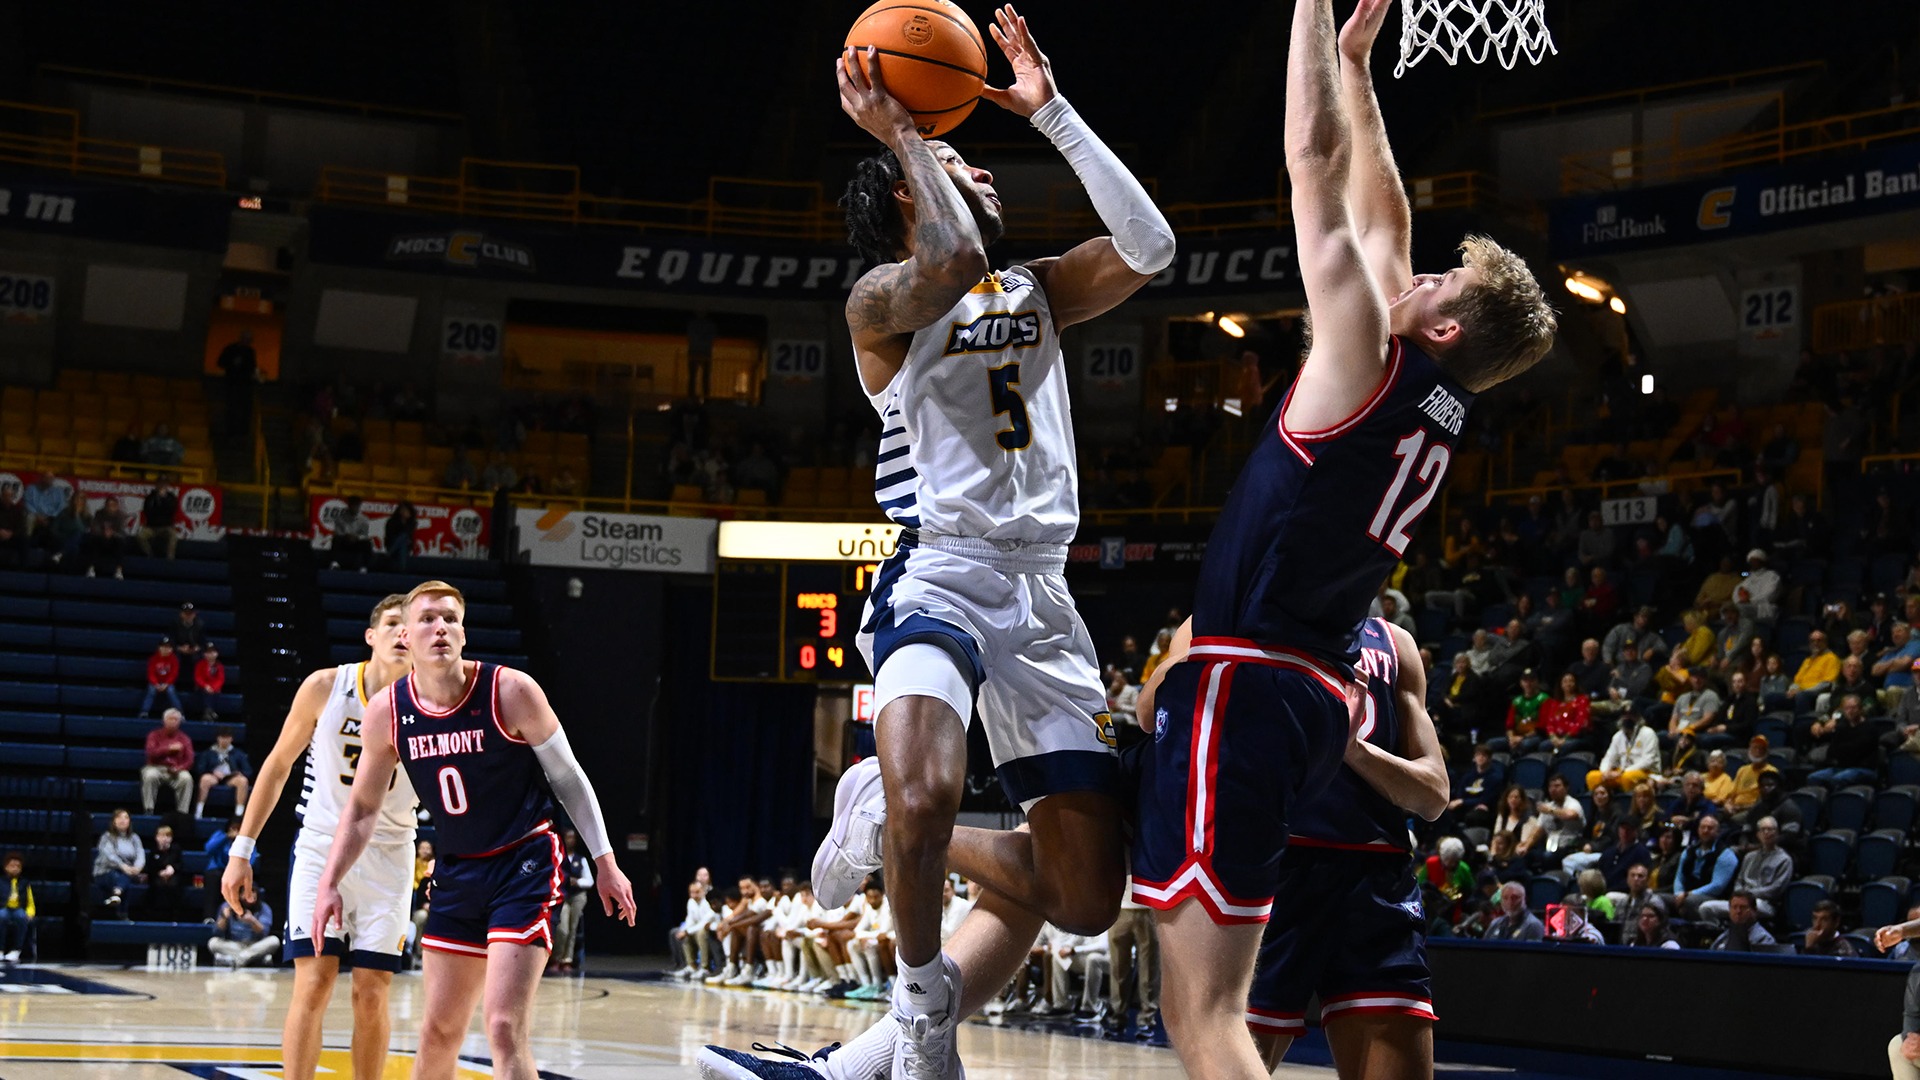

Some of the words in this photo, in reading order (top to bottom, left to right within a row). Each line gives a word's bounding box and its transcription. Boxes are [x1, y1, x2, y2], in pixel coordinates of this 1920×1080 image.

[1759, 174, 1856, 216] Official
[1864, 162, 1920, 199] Ban
[1582, 214, 1666, 244] FirstBank
[394, 237, 445, 255] MOCS
[482, 242, 530, 267] CLUB
[0, 277, 49, 309] 208
[1746, 290, 1793, 326] 212
[447, 322, 497, 352] 209
[776, 343, 821, 371] 210
[1090, 347, 1133, 376] 210
[988, 362, 1033, 451] 5
[1417, 384, 1466, 436] FRIBERG
[1366, 426, 1451, 559] 12
[1612, 500, 1646, 521] 113
[582, 517, 663, 541] Steam
[581, 540, 682, 568] Logistics
[797, 593, 837, 609] MOCS
[819, 609, 837, 638] 3
[800, 645, 816, 669] 0
[827, 647, 844, 668] 4
[407, 729, 484, 761] BELMONT
[437, 765, 468, 815] 0
